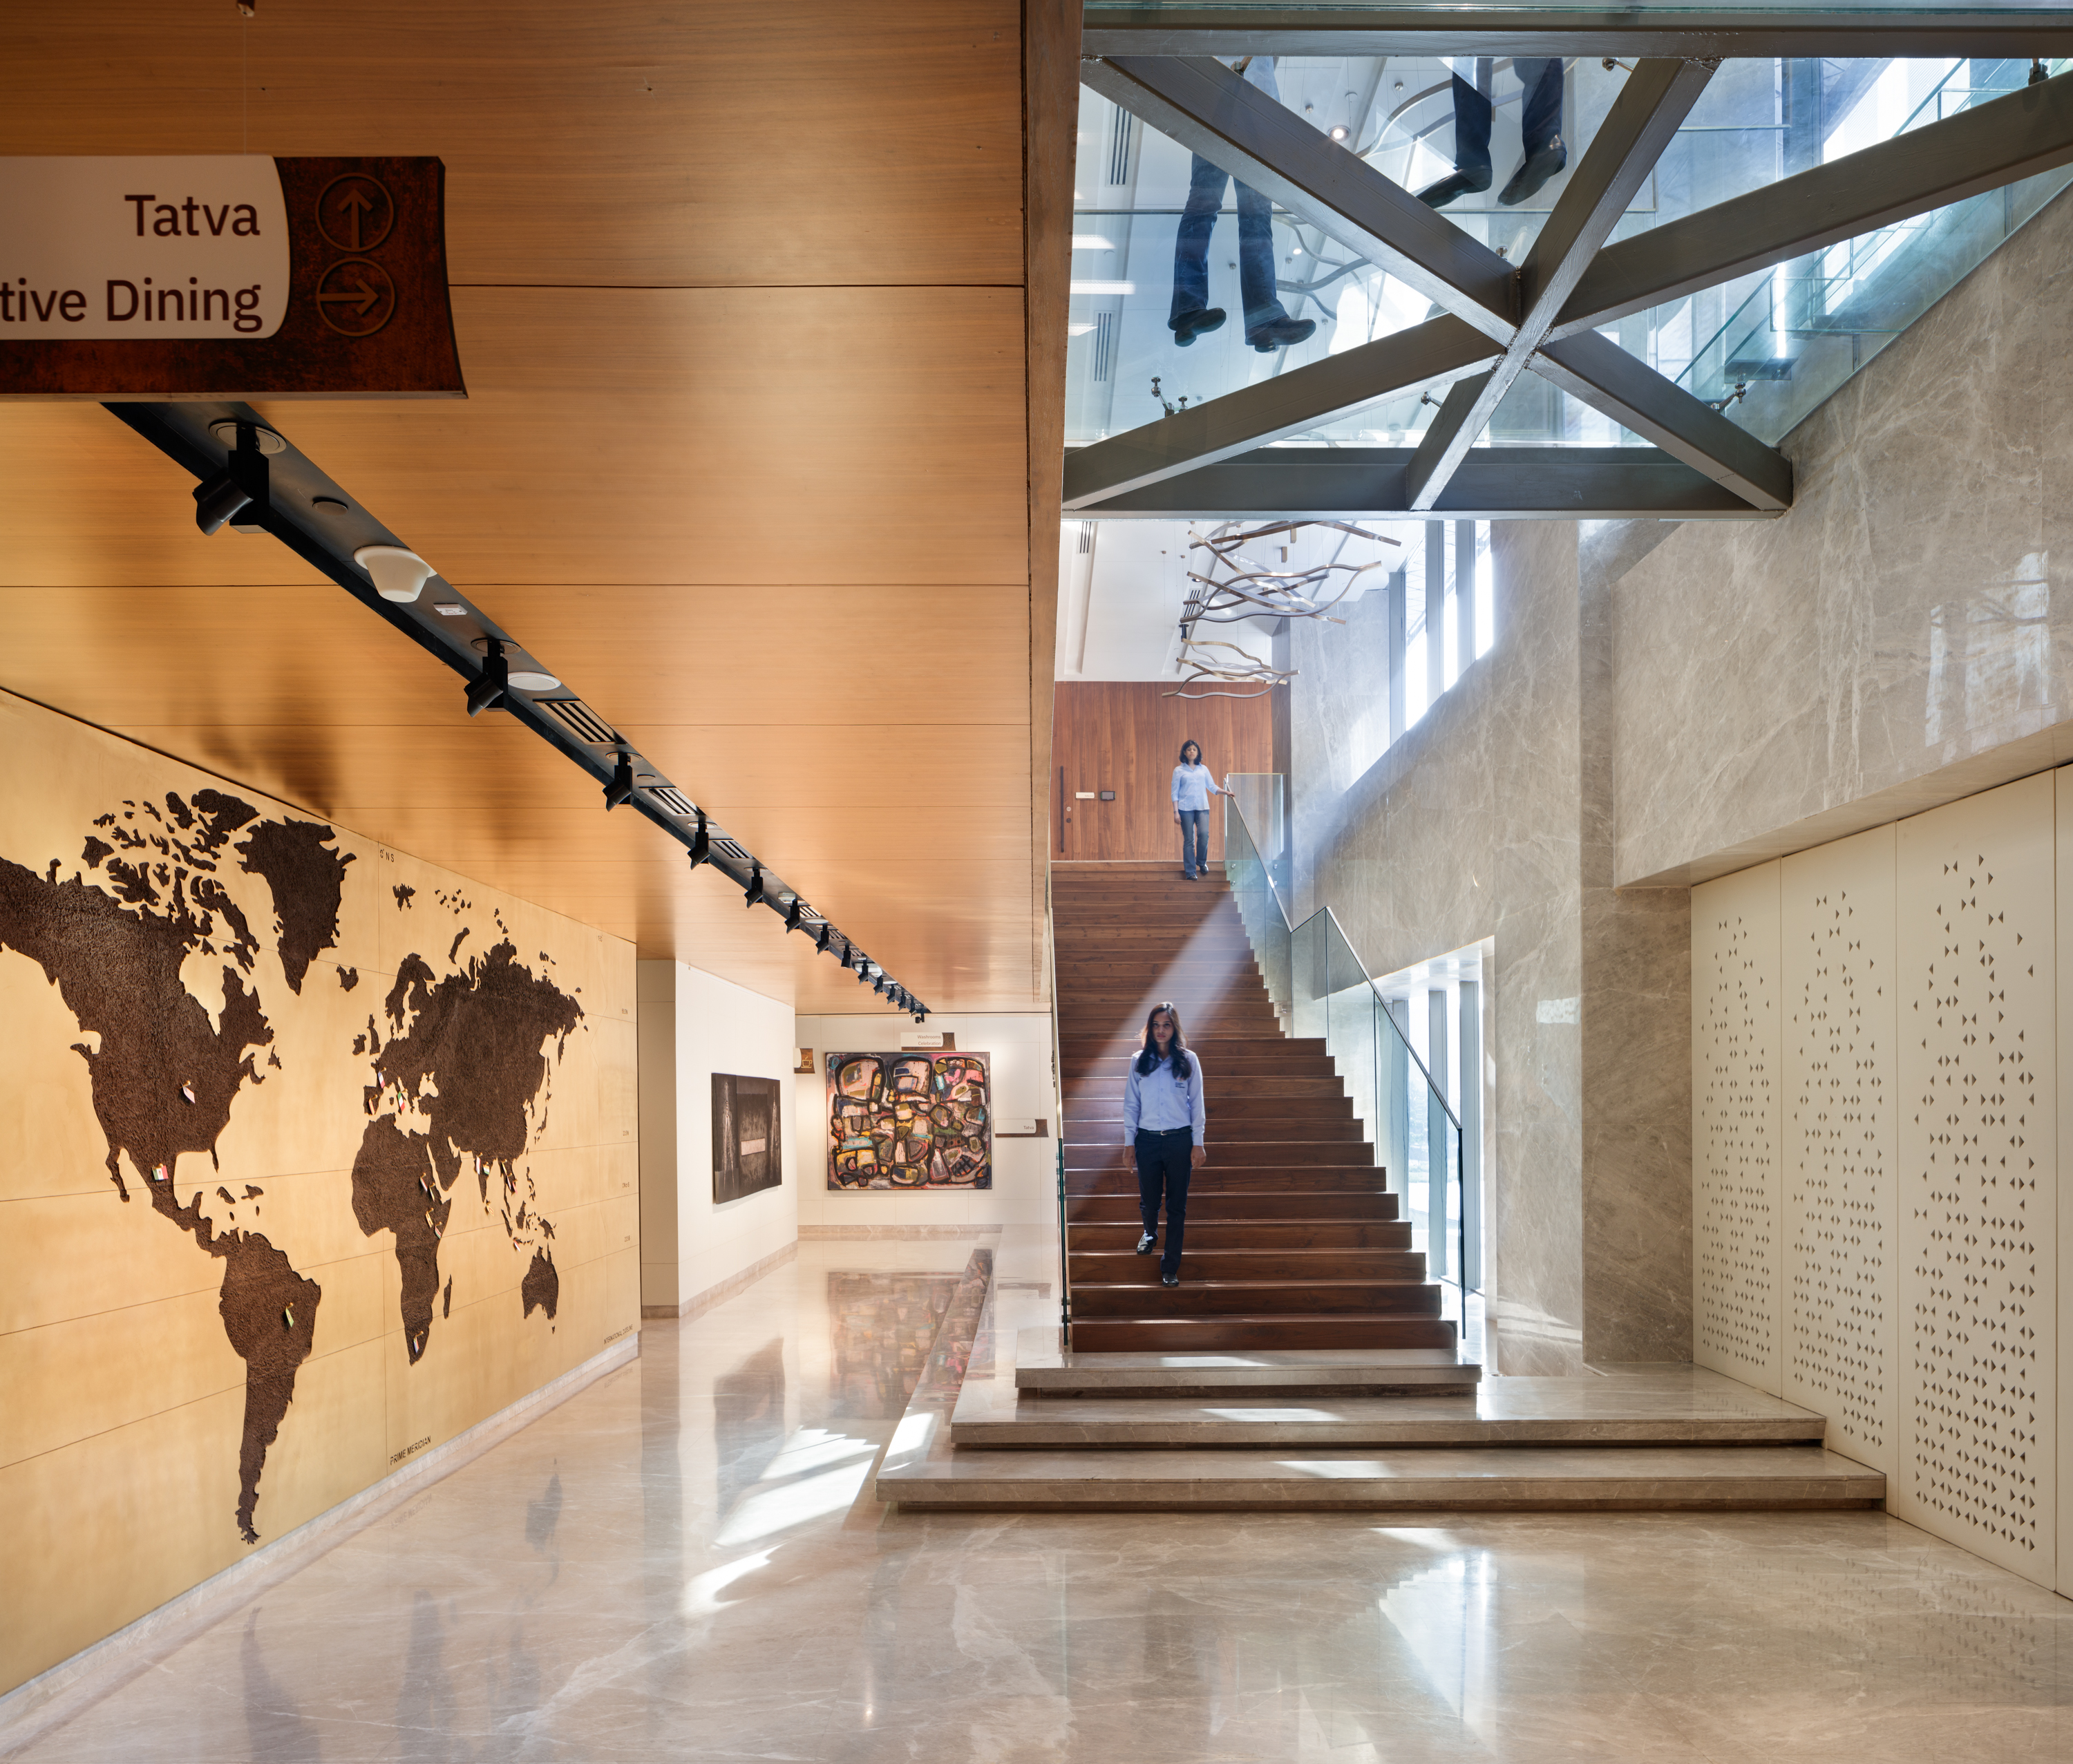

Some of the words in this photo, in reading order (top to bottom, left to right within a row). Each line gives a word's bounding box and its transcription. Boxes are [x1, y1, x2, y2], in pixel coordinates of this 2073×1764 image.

[124, 194, 261, 237] Tatva
[0, 277, 87, 323] tive
[106, 277, 263, 333] Dining
[390, 1448, 406, 1466] PRIME
[407, 1434, 431, 1456] MERIDIAN
